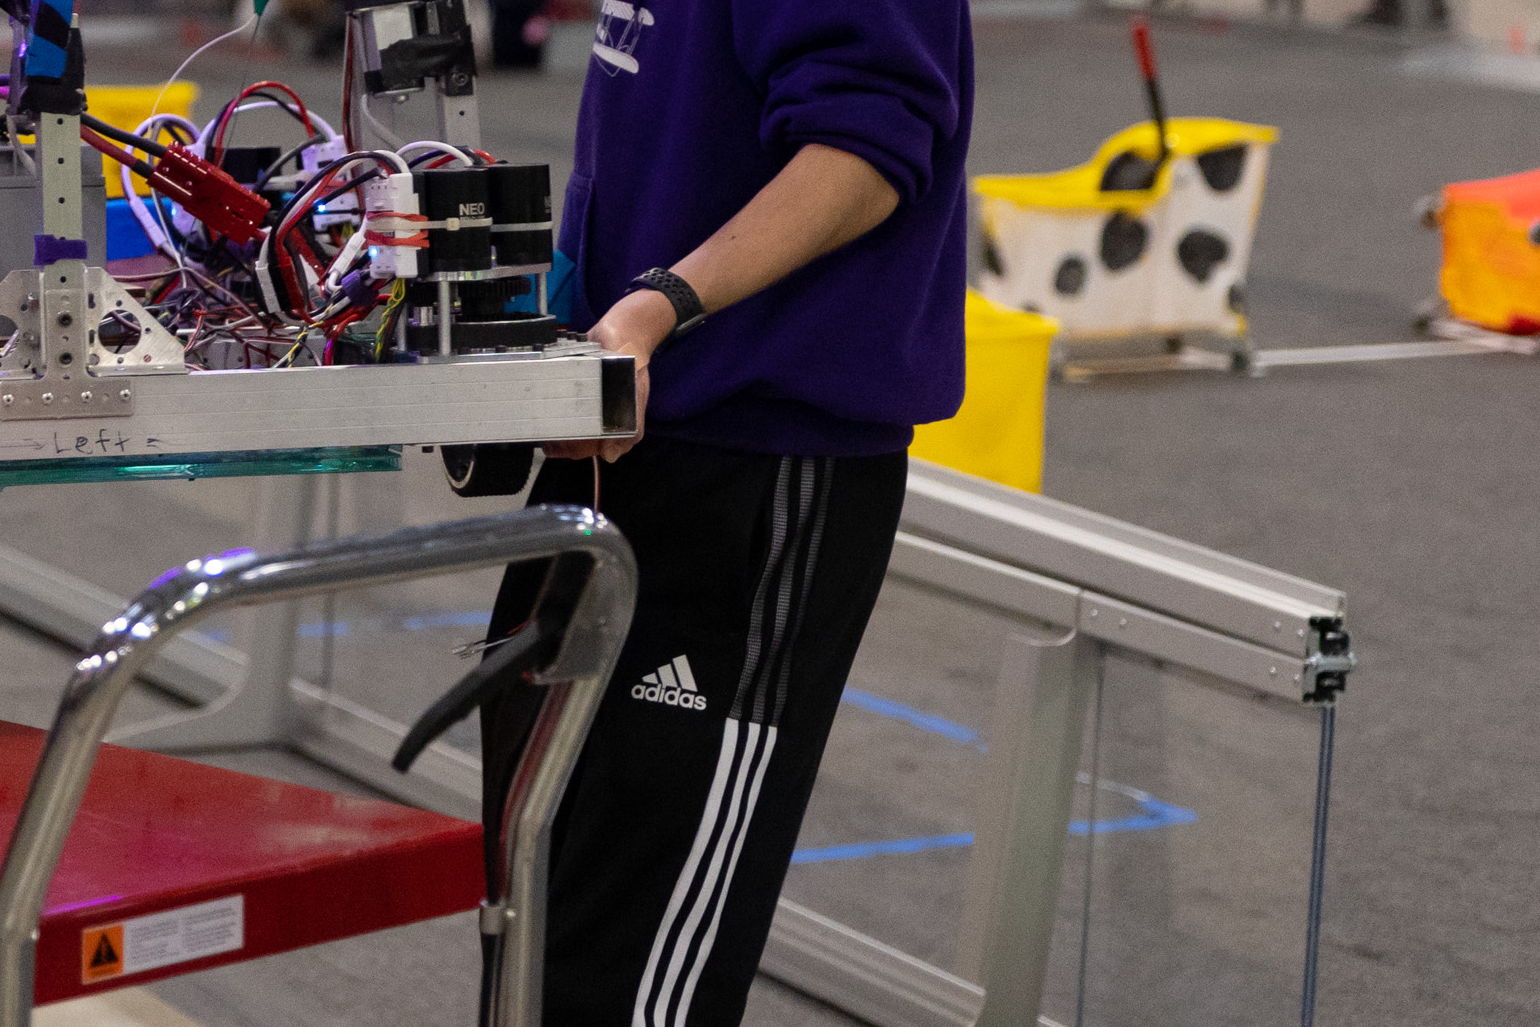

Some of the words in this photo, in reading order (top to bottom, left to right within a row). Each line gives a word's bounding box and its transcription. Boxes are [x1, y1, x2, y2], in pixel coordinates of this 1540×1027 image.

[459, 203, 485, 216] NEO
[53, 428, 131, 455] Left
[630, 683, 708, 711] adidas
